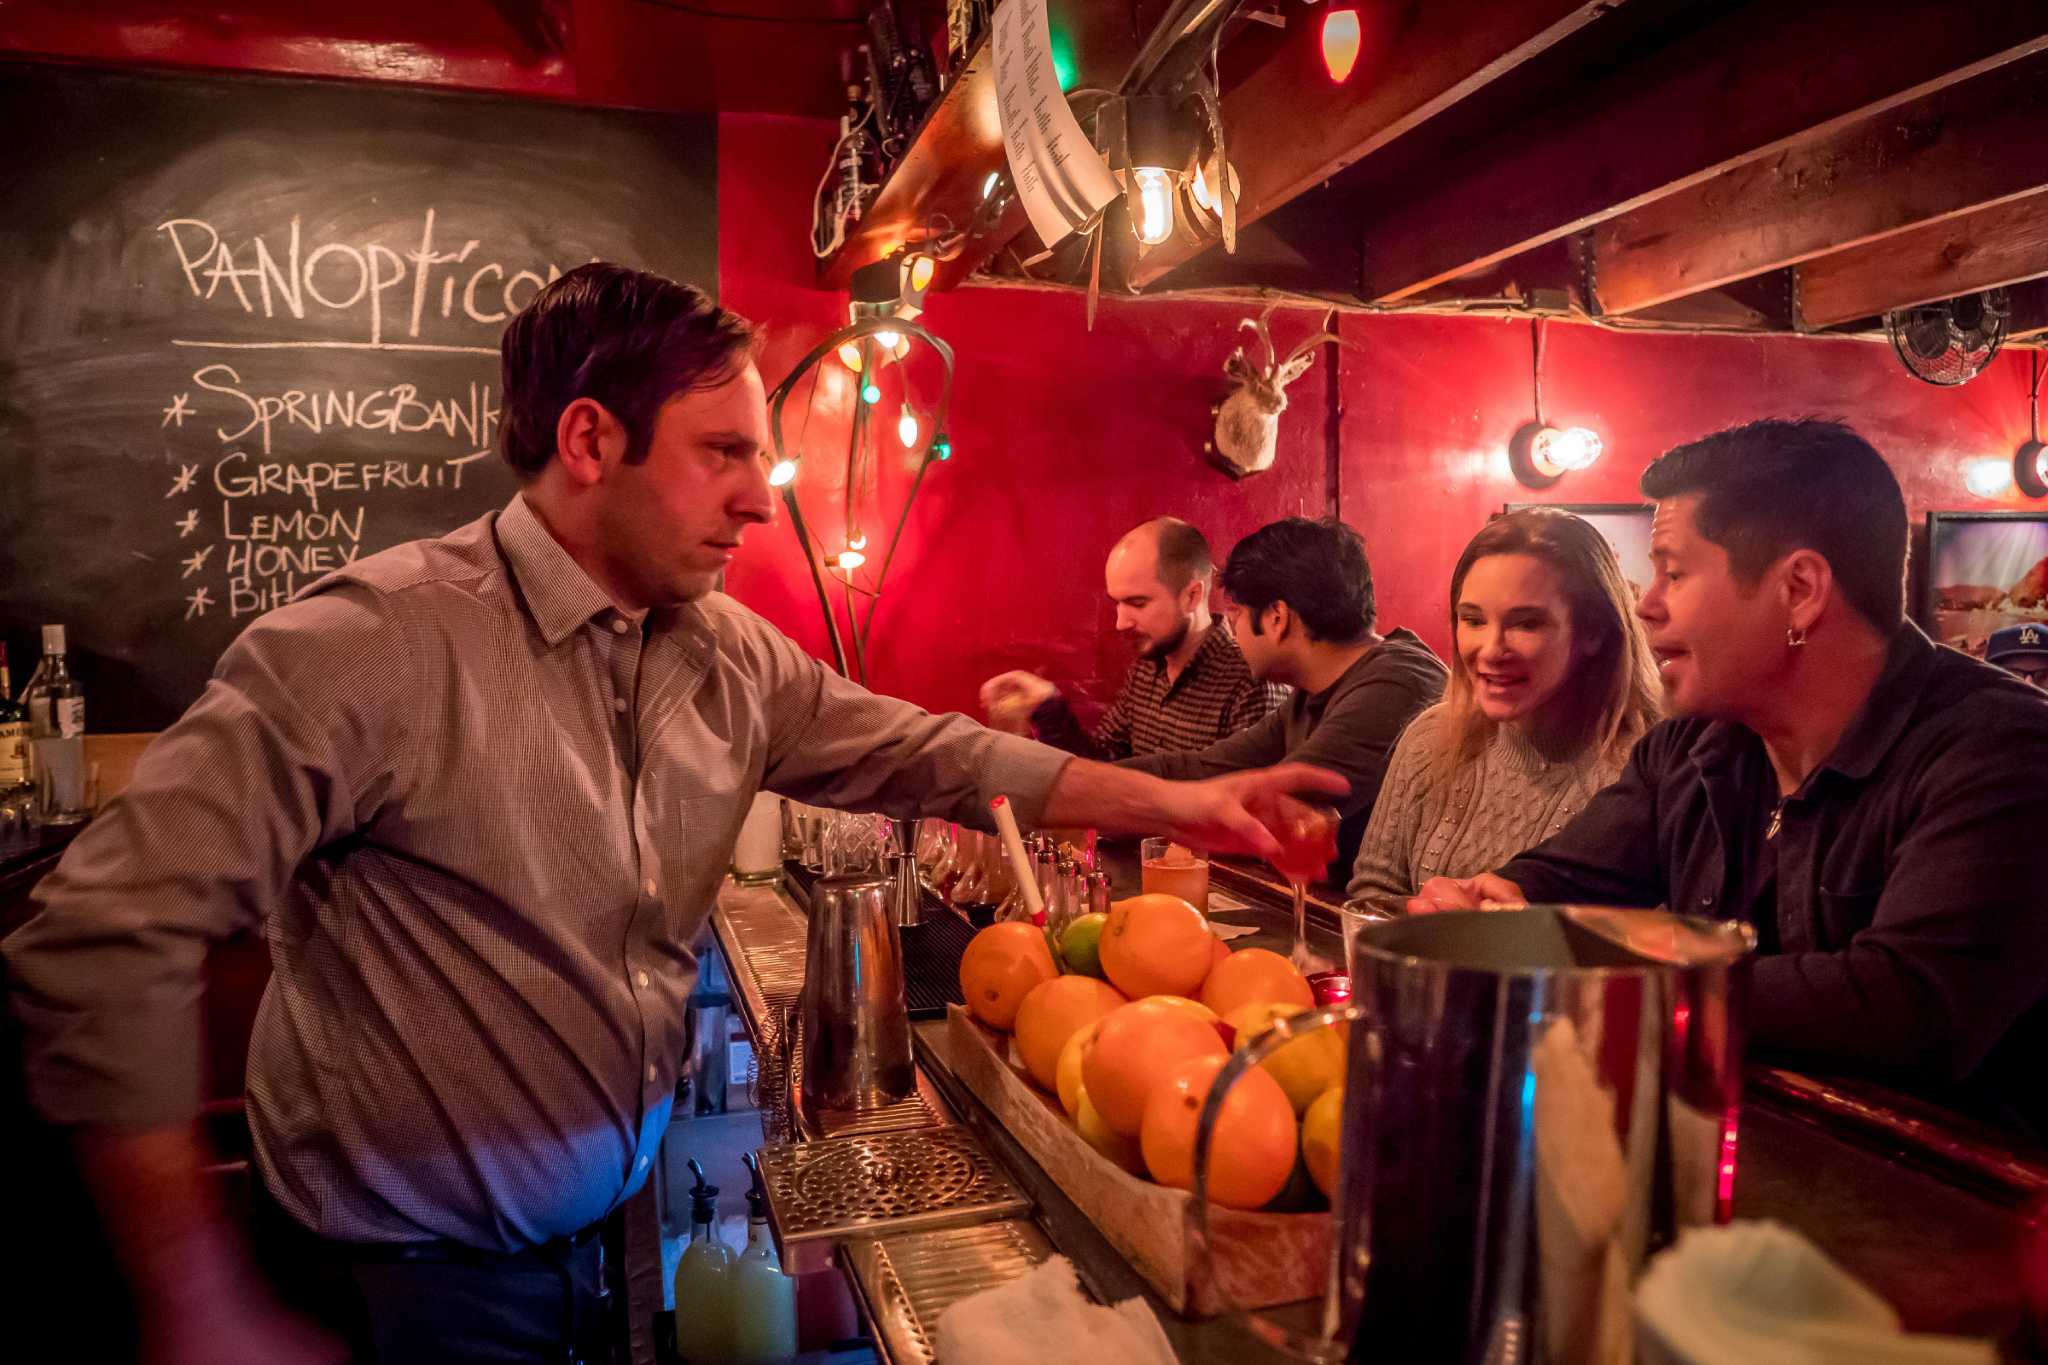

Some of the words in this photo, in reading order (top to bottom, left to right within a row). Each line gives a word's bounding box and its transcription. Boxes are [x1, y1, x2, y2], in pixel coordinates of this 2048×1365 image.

[193, 363, 501, 454] SPRINGBANK
[213, 449, 493, 512] GRAPEFRUIT
[223, 500, 365, 542] LEMON
[226, 542, 360, 587] HONEY
[2019, 625, 2040, 645] LA
